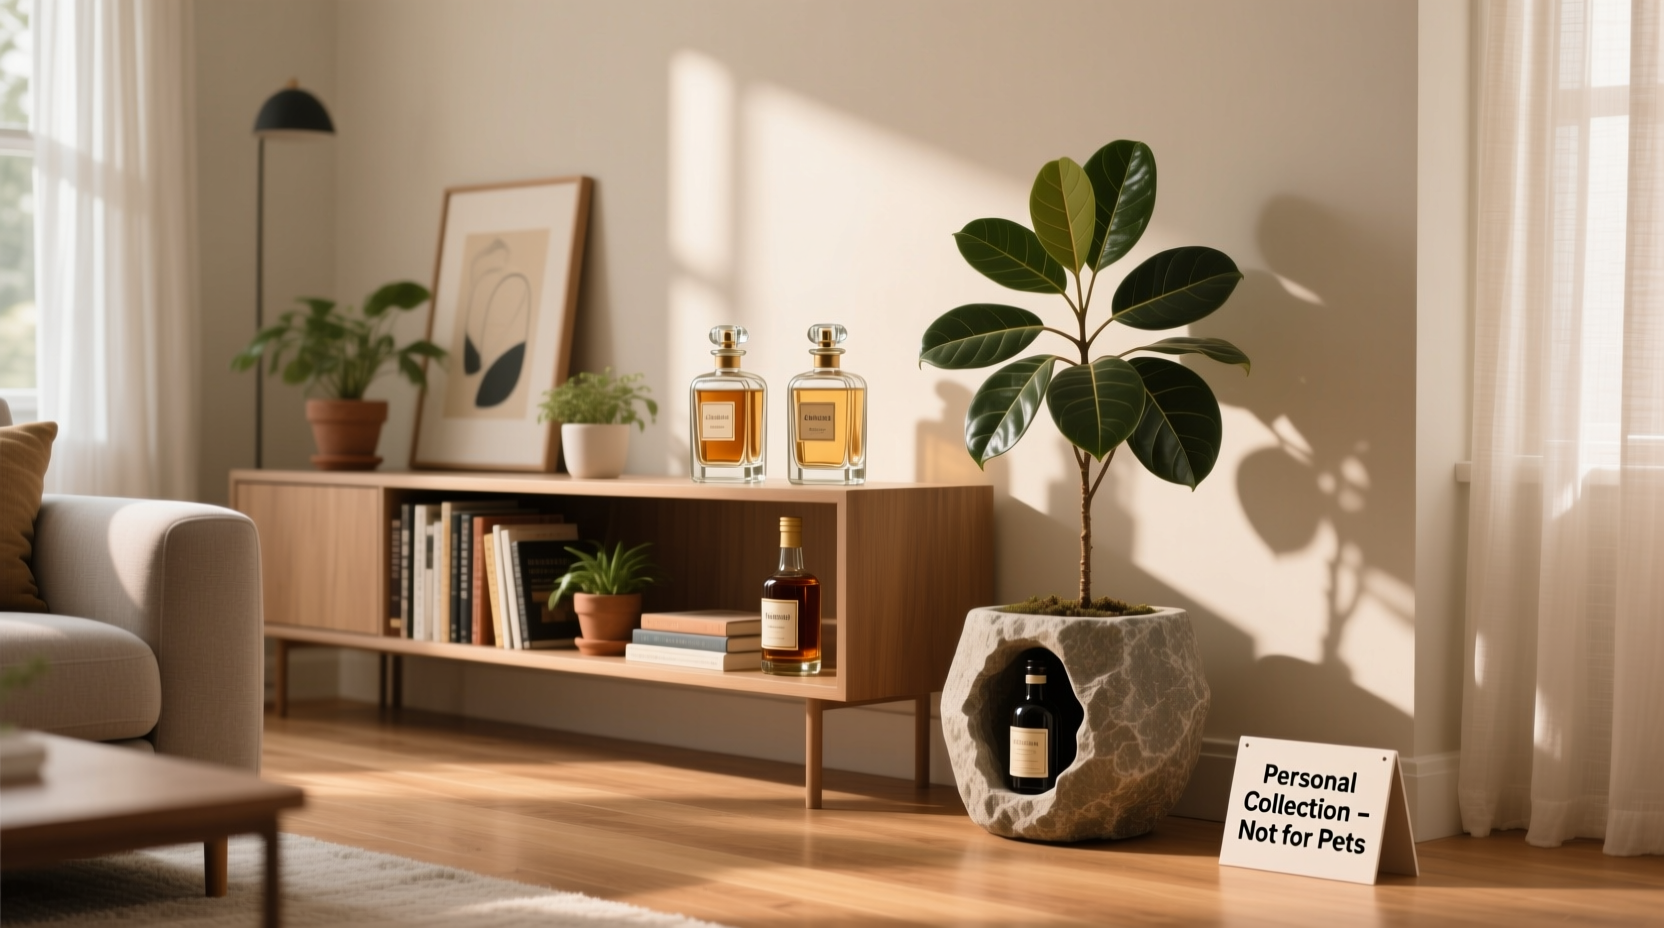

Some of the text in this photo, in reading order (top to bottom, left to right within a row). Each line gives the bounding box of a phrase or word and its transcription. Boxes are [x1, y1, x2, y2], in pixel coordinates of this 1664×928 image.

[1264, 764, 1357, 793] Personal
[1244, 791, 1350, 821] Collection
[1238, 820, 1366, 854] Not for Pets
